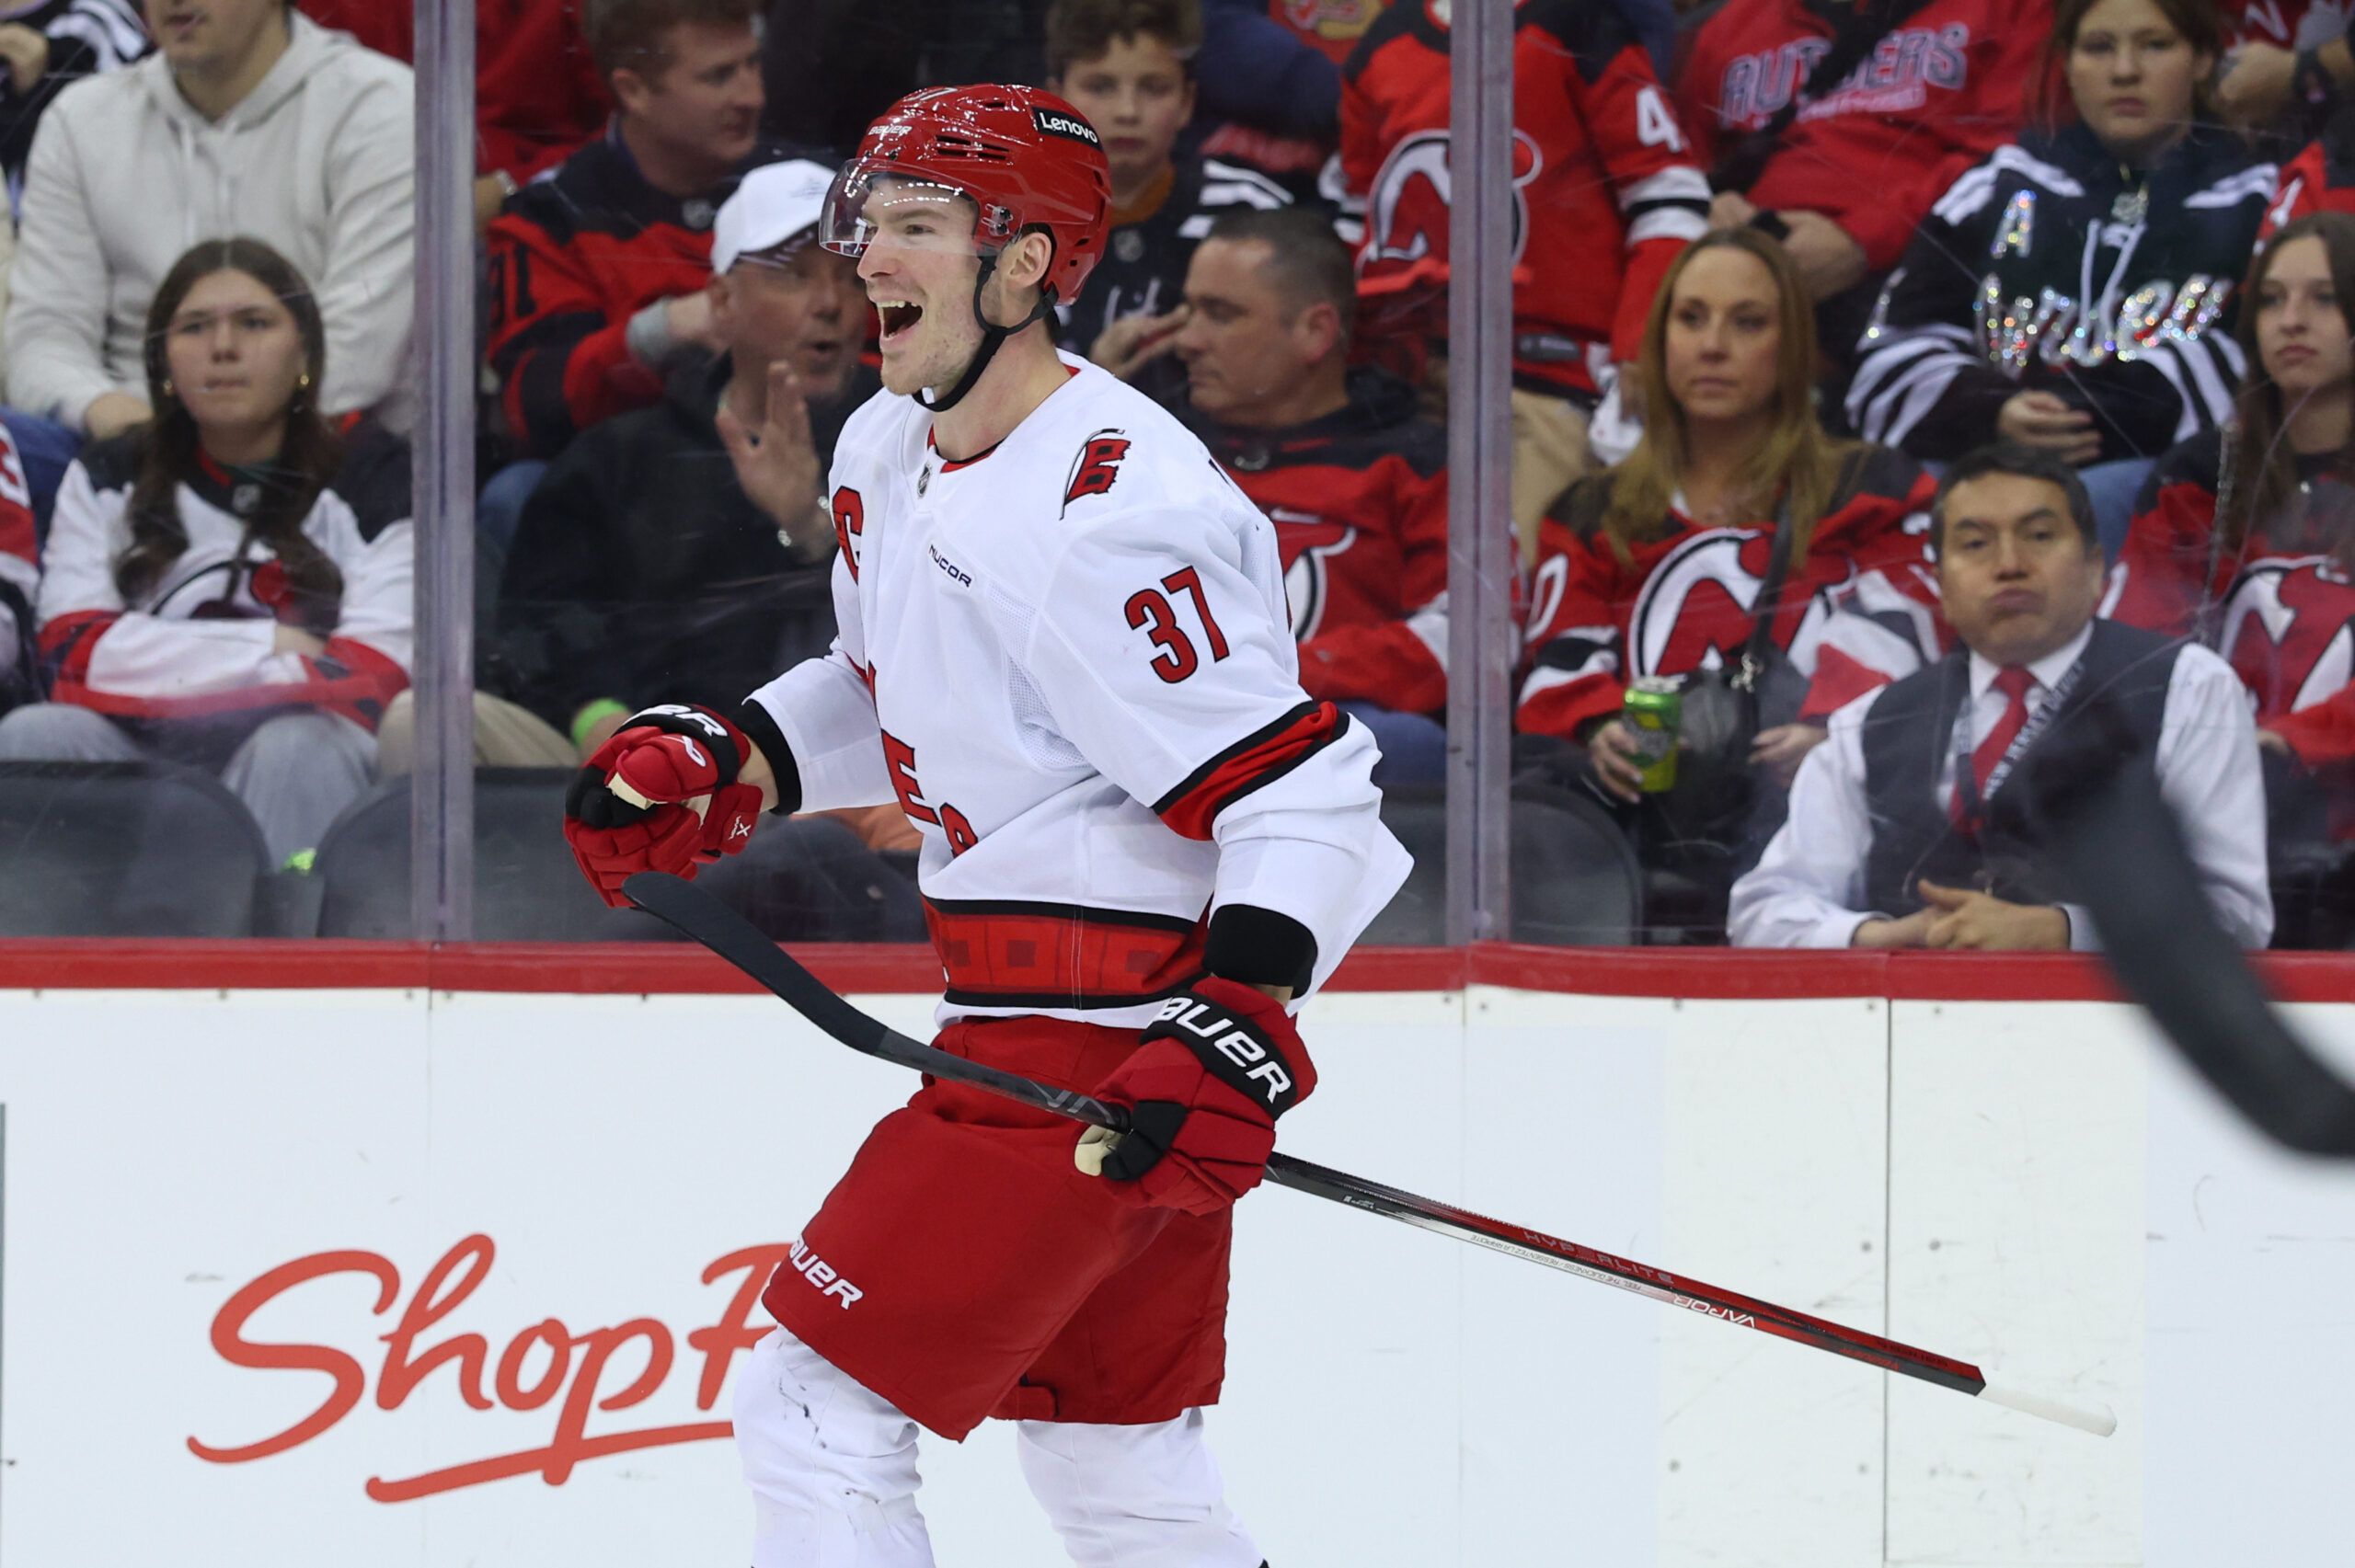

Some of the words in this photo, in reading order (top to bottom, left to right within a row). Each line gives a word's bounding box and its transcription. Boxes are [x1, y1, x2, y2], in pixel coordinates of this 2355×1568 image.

[1040, 112, 1097, 143] Lenovo
[1719, 21, 1970, 129] RUTERS
[928, 544, 972, 588] NUCOR
[1124, 565, 1230, 684] 37
[1157, 997, 1291, 1104] AUER
[187, 1233, 793, 1485] ShopR
[1672, 1292, 1755, 1329] VAPOR
